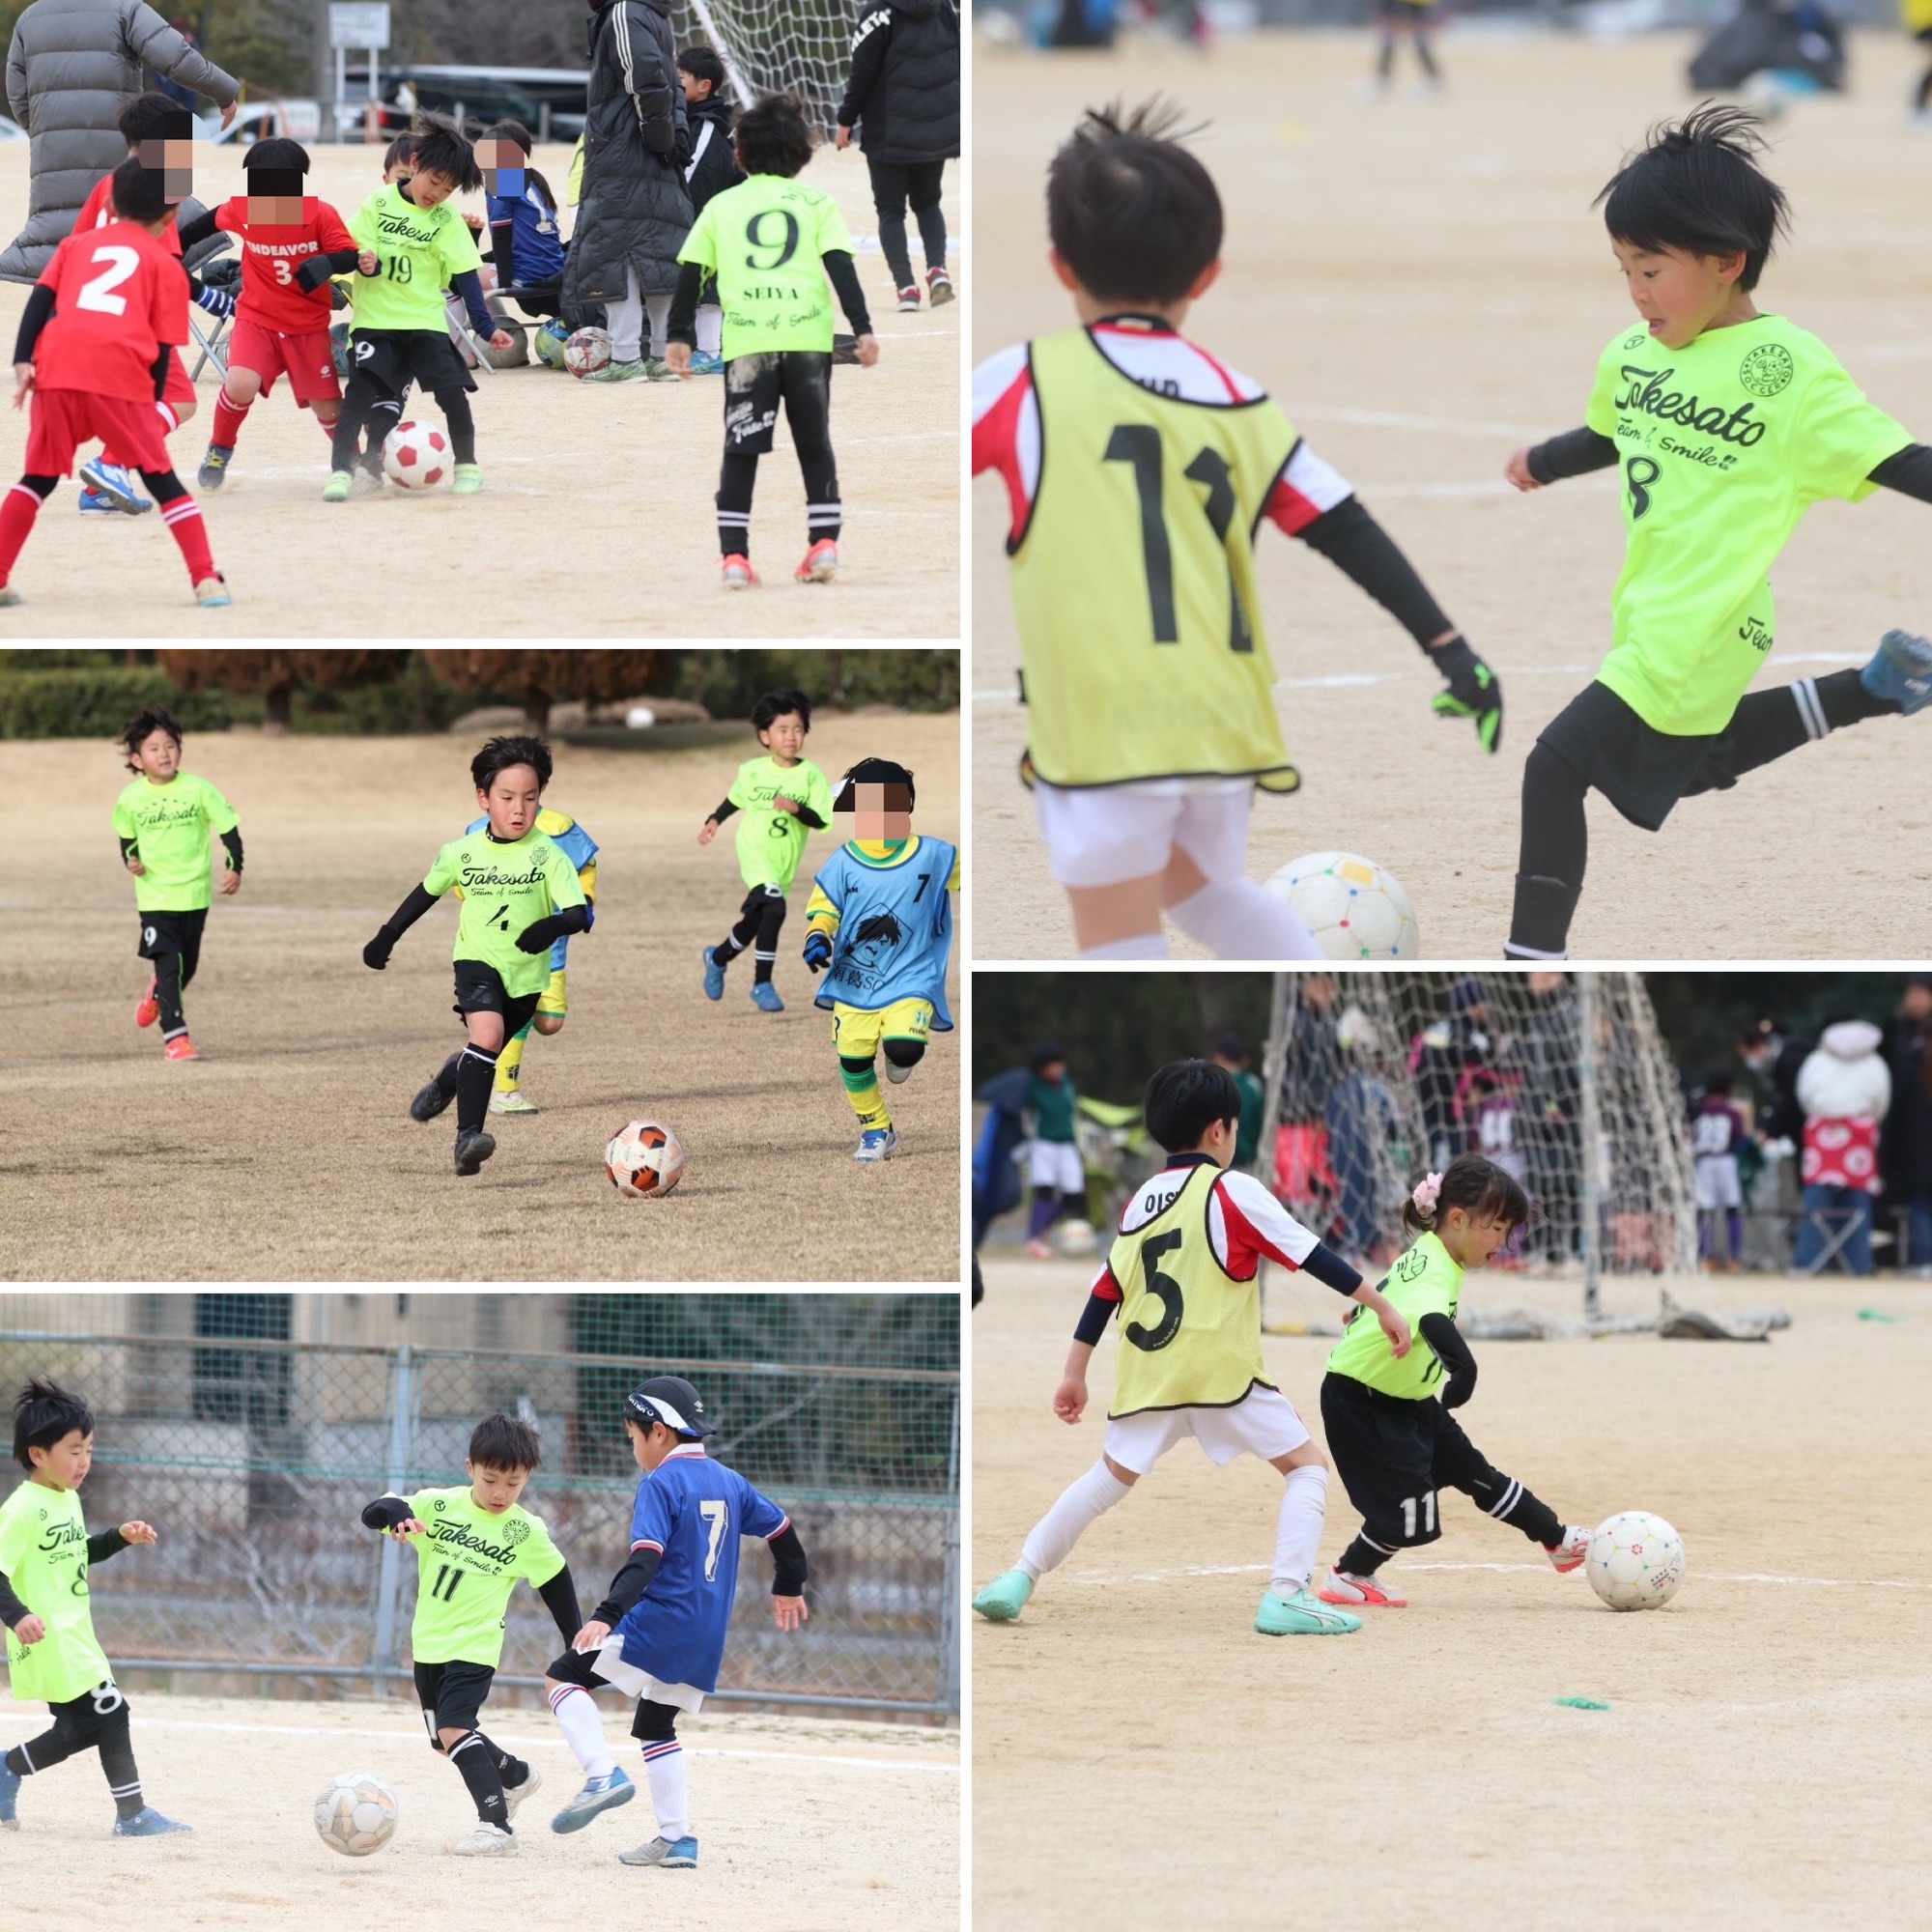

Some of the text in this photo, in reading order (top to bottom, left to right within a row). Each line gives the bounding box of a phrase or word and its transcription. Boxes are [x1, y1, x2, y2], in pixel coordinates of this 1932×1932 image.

[746, 209, 800, 270] 9
[76, 244, 140, 316] 2
[272, 260, 293, 286] 3
[387, 254, 412, 284] 19
[743, 287, 800, 301] SEIYA
[725, 311, 756, 327] Team
[1743, 369, 1782, 395] SOCCER
[1614, 365, 1766, 447] Takesato
[1103, 424, 1254, 653] 11
[768, 817, 788, 838] 8
[459, 866, 546, 887] Takesato
[913, 874, 930, 903] 7
[469, 888, 494, 896] Team
[486, 904, 510, 931] 4
[144, 925, 157, 948] 9
[1125, 1228, 1184, 1351] 5
[1399, 1490, 1435, 1539] 11
[426, 1519, 517, 1565] Takesato
[699, 1500, 728, 1582] 7
[431, 1563, 466, 1603] 11
[91, 1679, 123, 1715] 8
